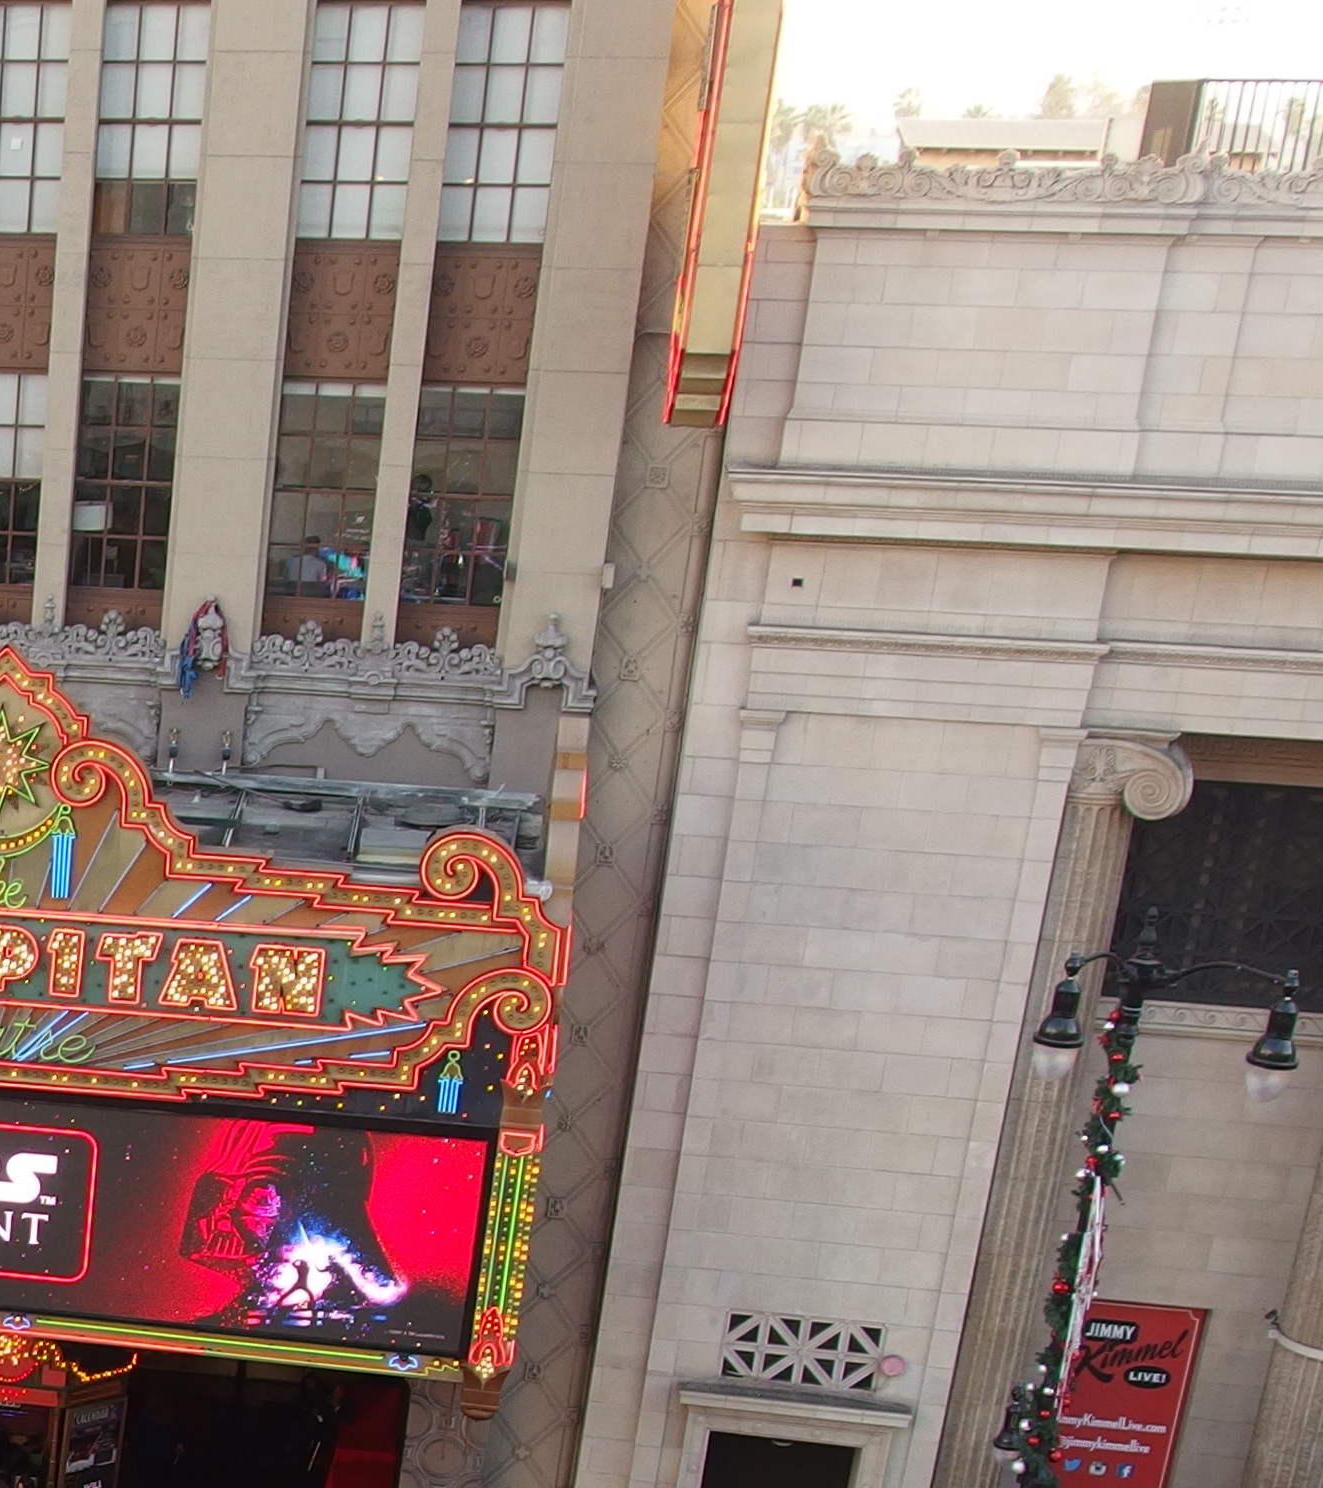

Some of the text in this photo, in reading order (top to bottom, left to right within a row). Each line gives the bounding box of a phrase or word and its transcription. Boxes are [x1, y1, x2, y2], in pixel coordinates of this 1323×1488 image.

[1085, 1322, 1137, 1341] JIMMY
[1074, 1329, 1190, 1384] Kimmel
[1128, 1370, 1167, 1384] LIVE!
